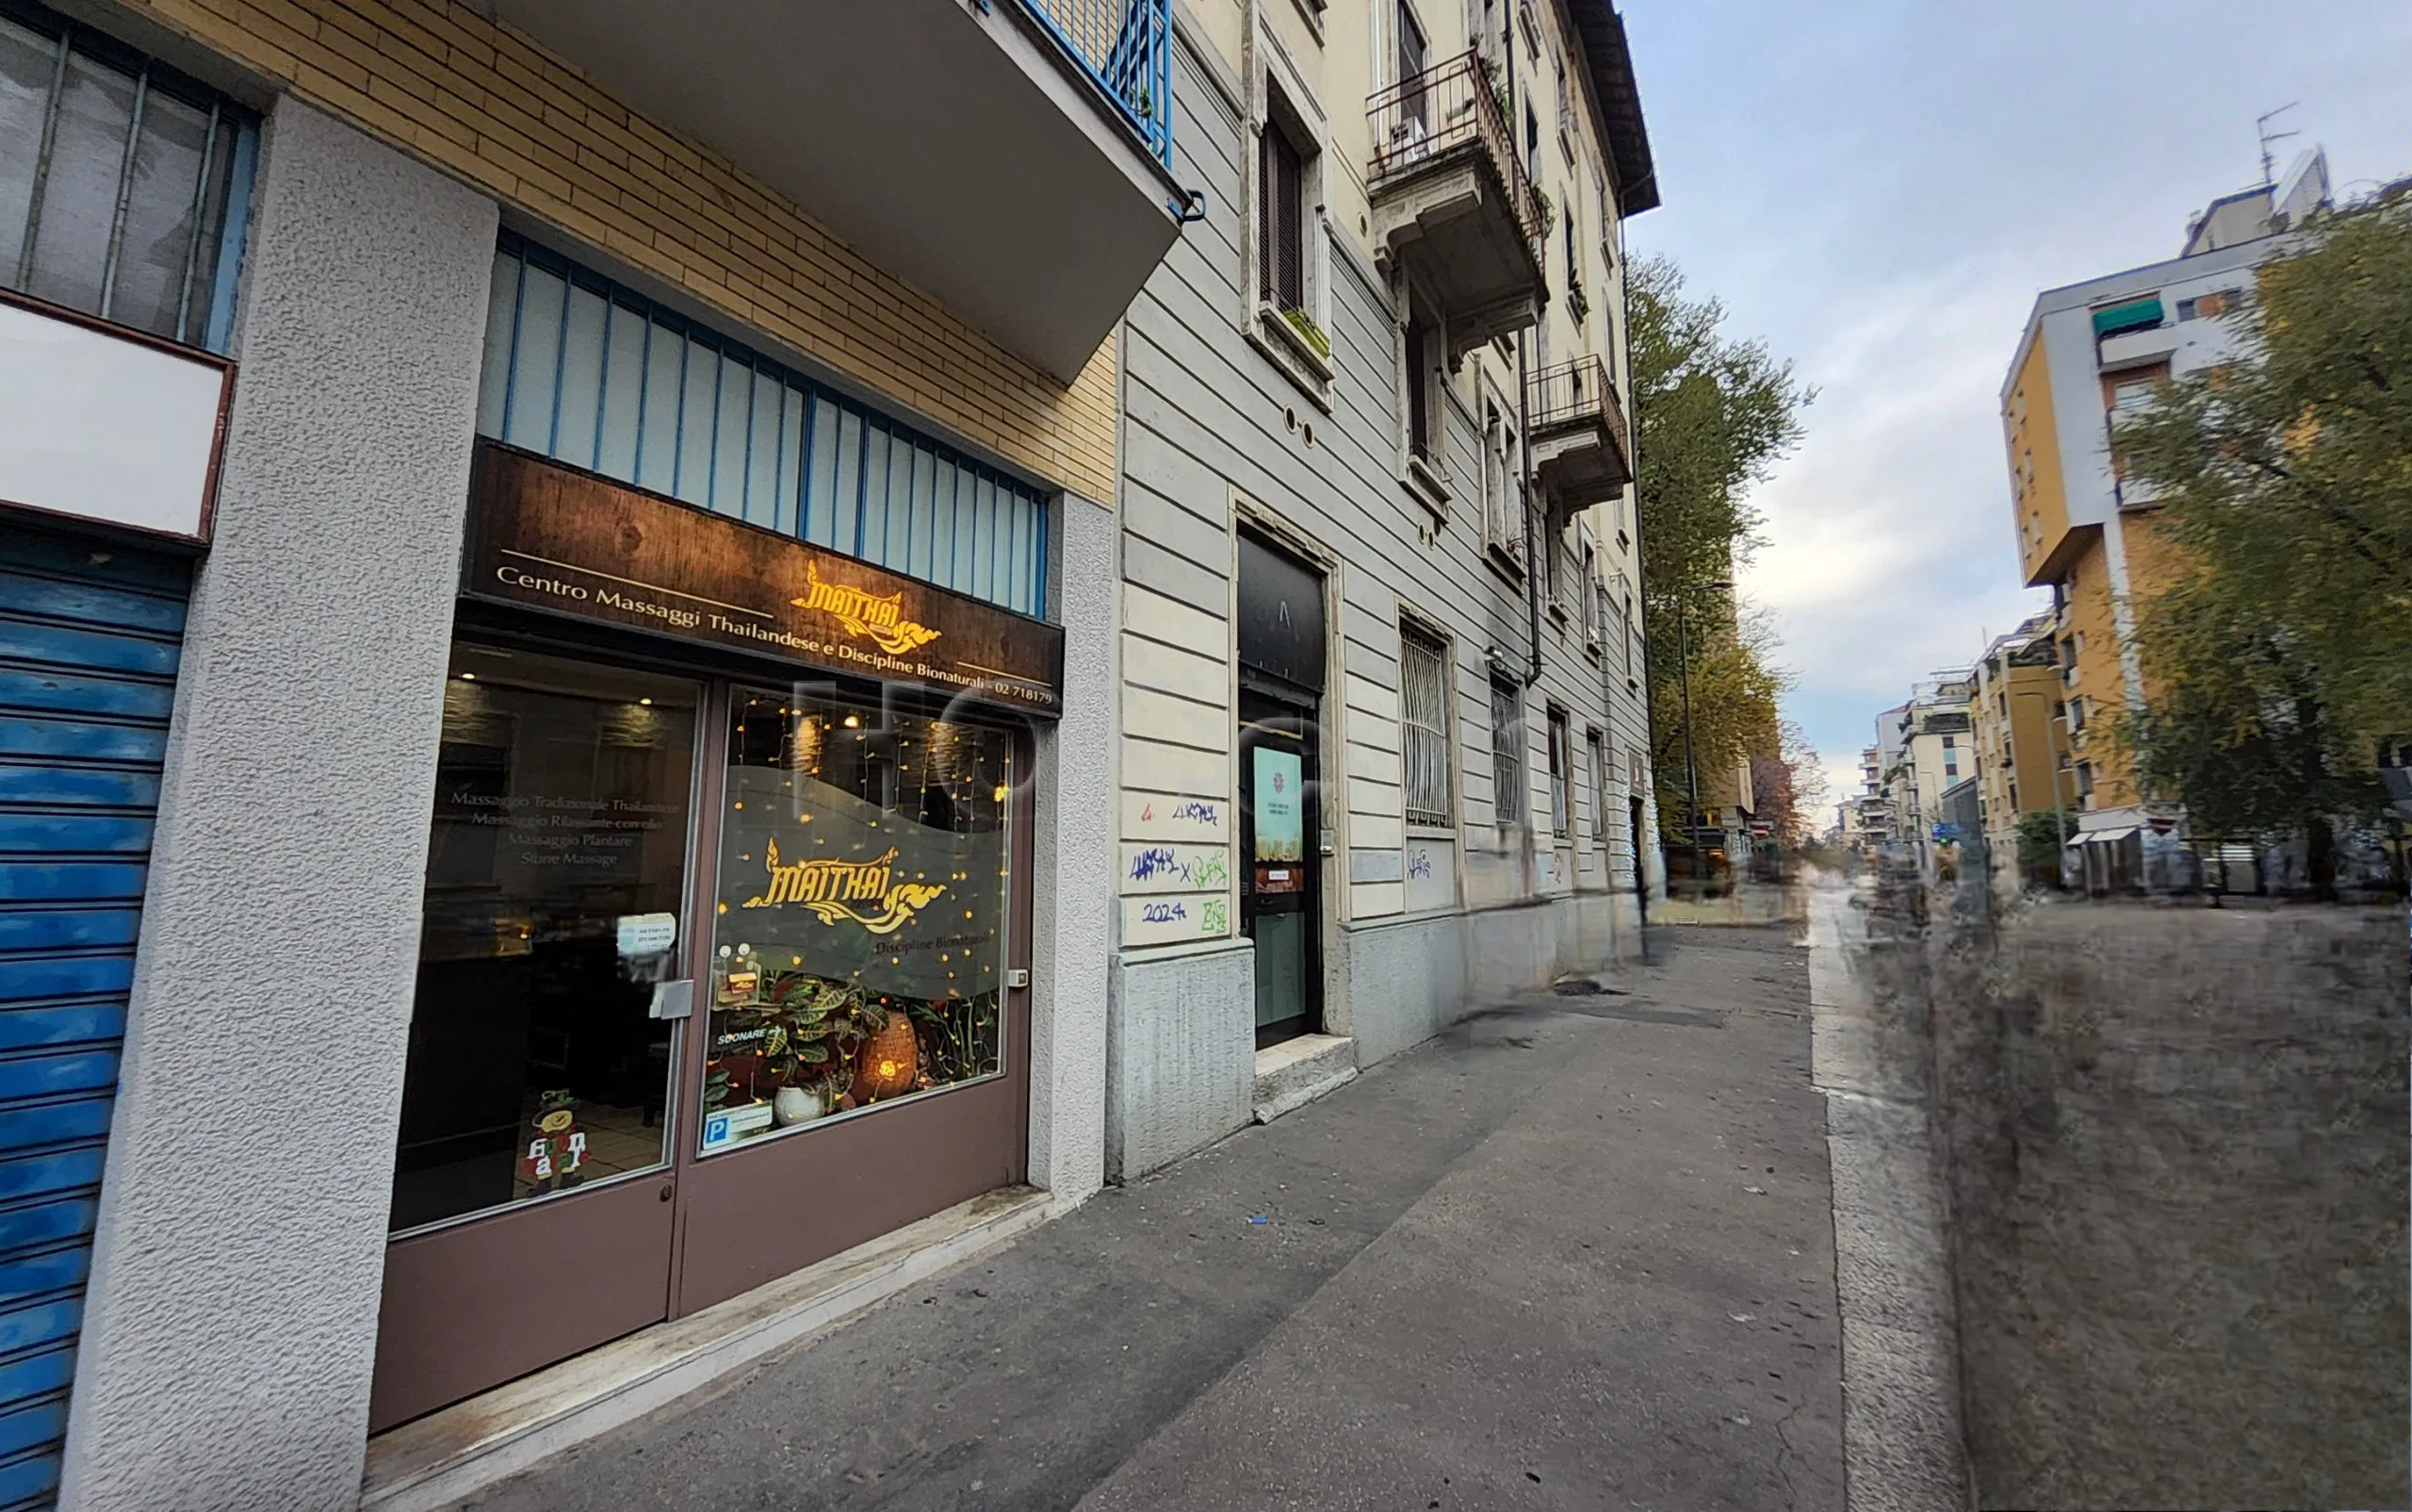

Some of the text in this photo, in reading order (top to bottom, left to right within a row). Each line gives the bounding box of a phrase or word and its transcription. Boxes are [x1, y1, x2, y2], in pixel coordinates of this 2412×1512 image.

[496, 565, 588, 601] Centro
[595, 588, 701, 628] Massaggi
[708, 614, 819, 653] Thailandese
[823, 643, 835, 656] e
[839, 644, 914, 675] Discipline
[917, 663, 985, 690] Bionaturali
[995, 682, 1010, 696] 02
[1013, 685, 1053, 706] 718179
[451, 792, 530, 810] Massaggio
[471, 813, 547, 831] Massaggio
[508, 833, 633, 849] Massaggio Plantare
[563, 853, 618, 867] Massage
[765, 863, 891, 904] MAITHAI
[1142, 902, 1187, 923] 2024
[709, 1120, 725, 1141] P
